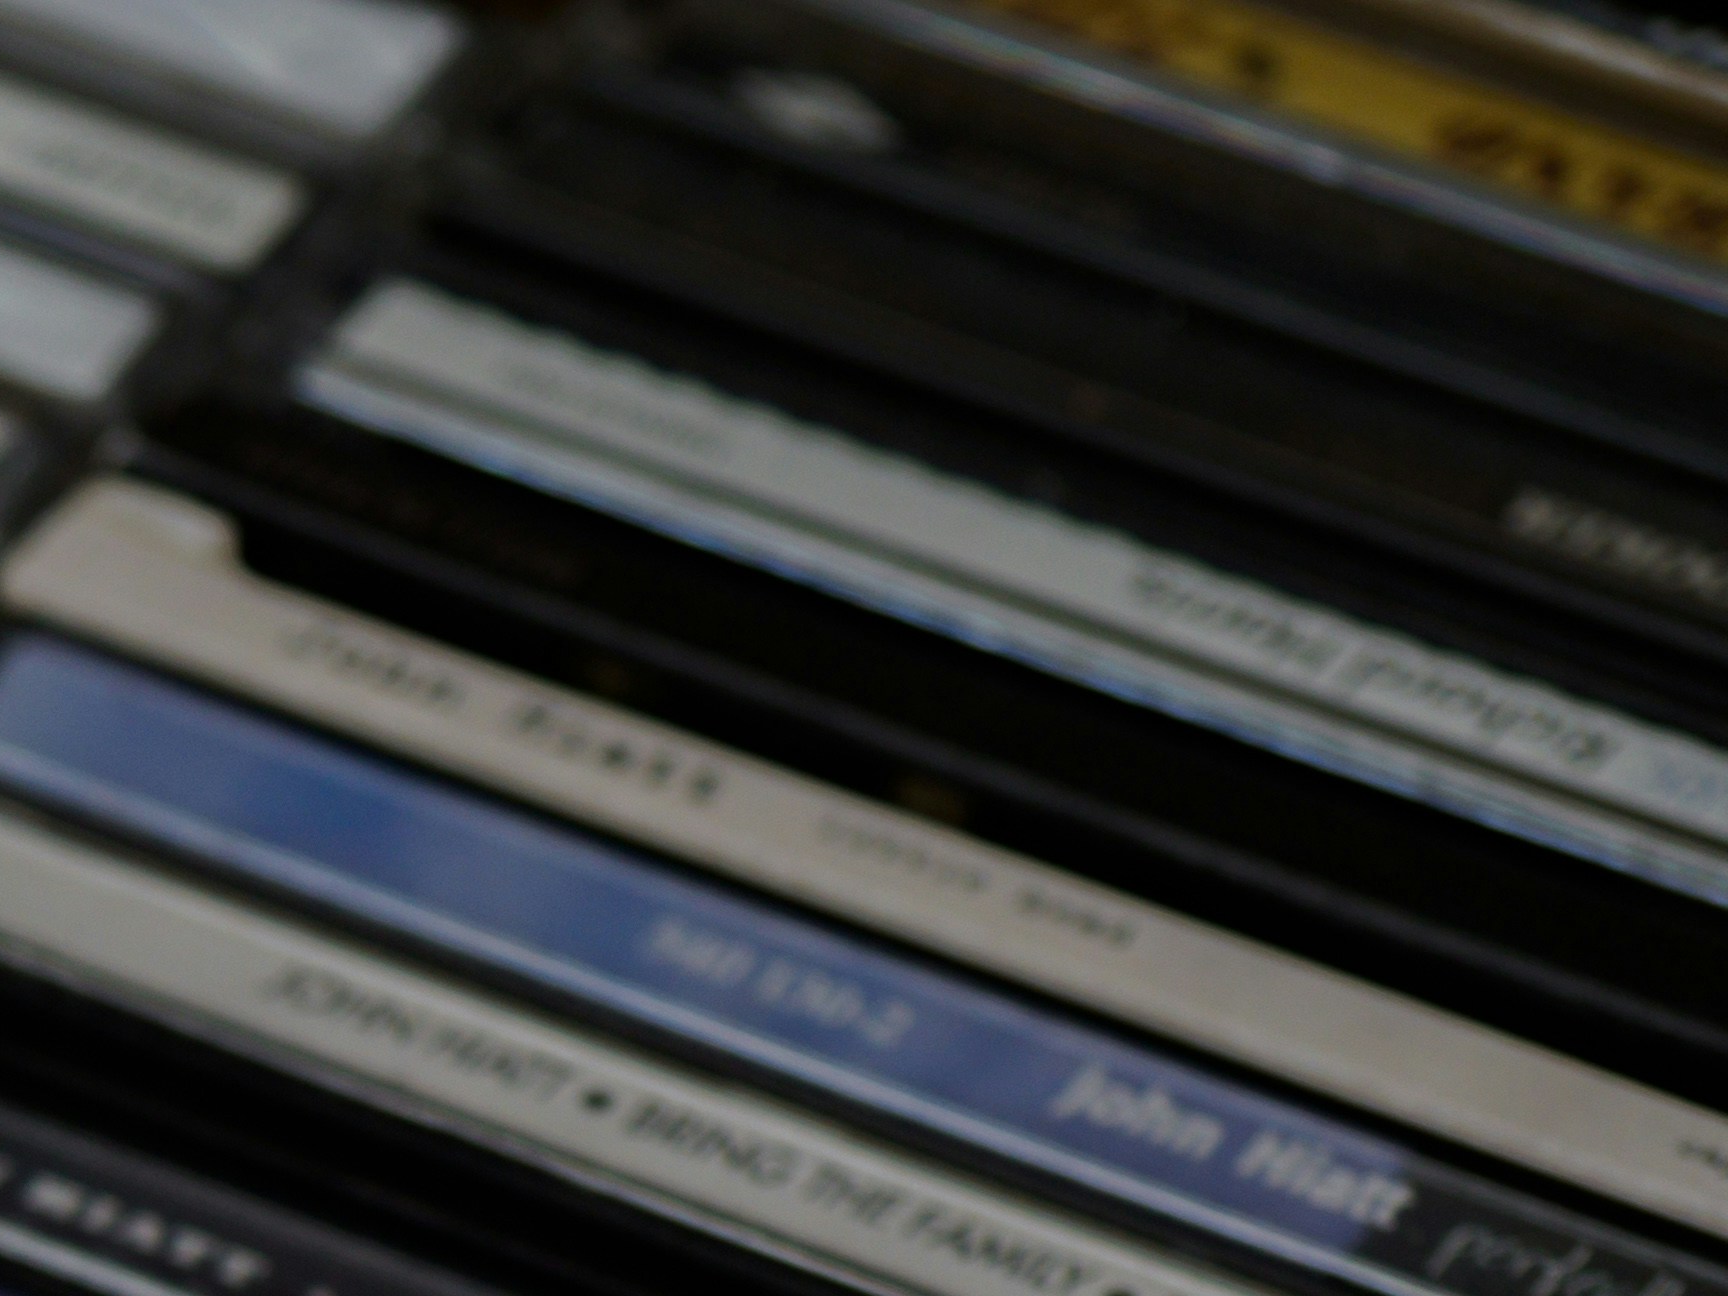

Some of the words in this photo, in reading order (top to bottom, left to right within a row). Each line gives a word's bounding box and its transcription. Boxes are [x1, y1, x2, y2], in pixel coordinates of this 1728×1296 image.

[1049, 1059, 1225, 1162] John
[1238, 1128, 1420, 1231] Hiatt
[25, 1160, 274, 1287] HIATT
